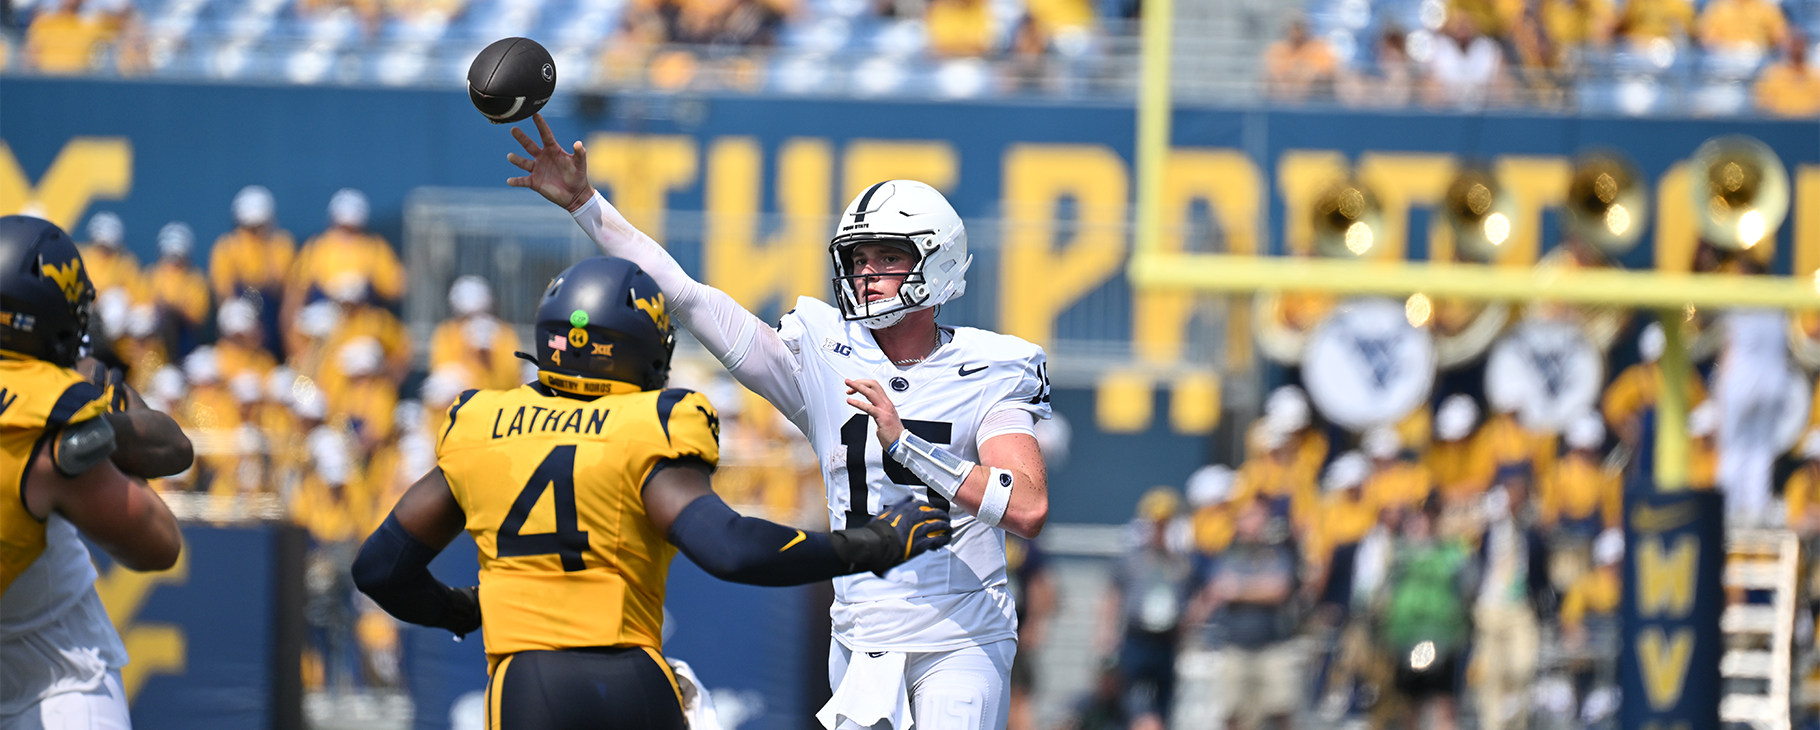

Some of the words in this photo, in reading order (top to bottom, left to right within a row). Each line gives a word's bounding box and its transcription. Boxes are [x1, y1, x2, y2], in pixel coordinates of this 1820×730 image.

[551, 349, 561, 366] 4
[492, 405, 610, 439] LATHAN
[497, 444, 592, 572] 4
[841, 412, 953, 531] 15
